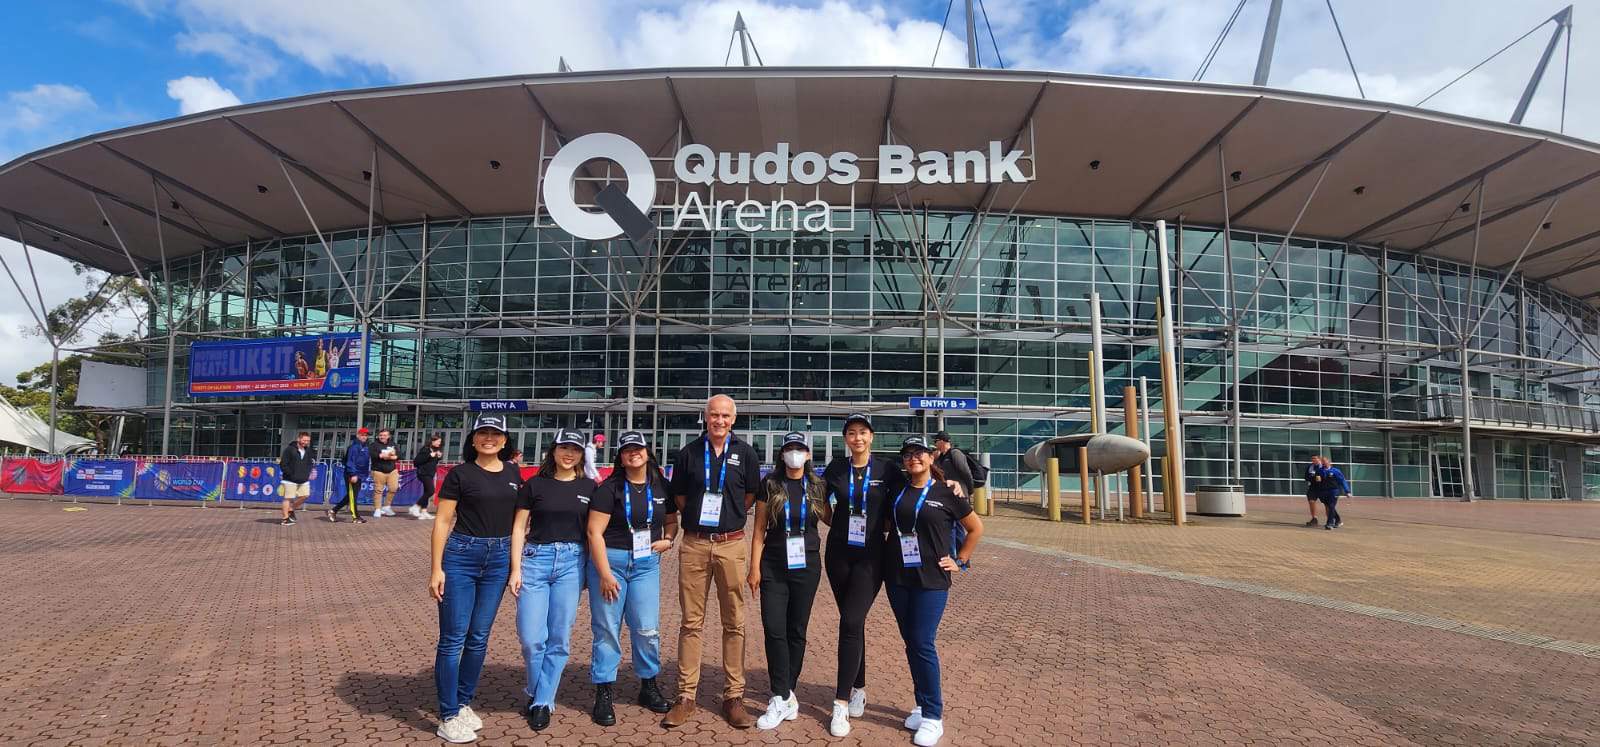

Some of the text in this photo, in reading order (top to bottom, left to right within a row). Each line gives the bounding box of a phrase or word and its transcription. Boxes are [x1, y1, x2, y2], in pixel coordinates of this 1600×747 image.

[674, 140, 1028, 187] Qudos Bank
[672, 191, 836, 233] Arena
[228, 345, 294, 375] LIKE IT
[920, 400, 958, 408] ENTRY B
